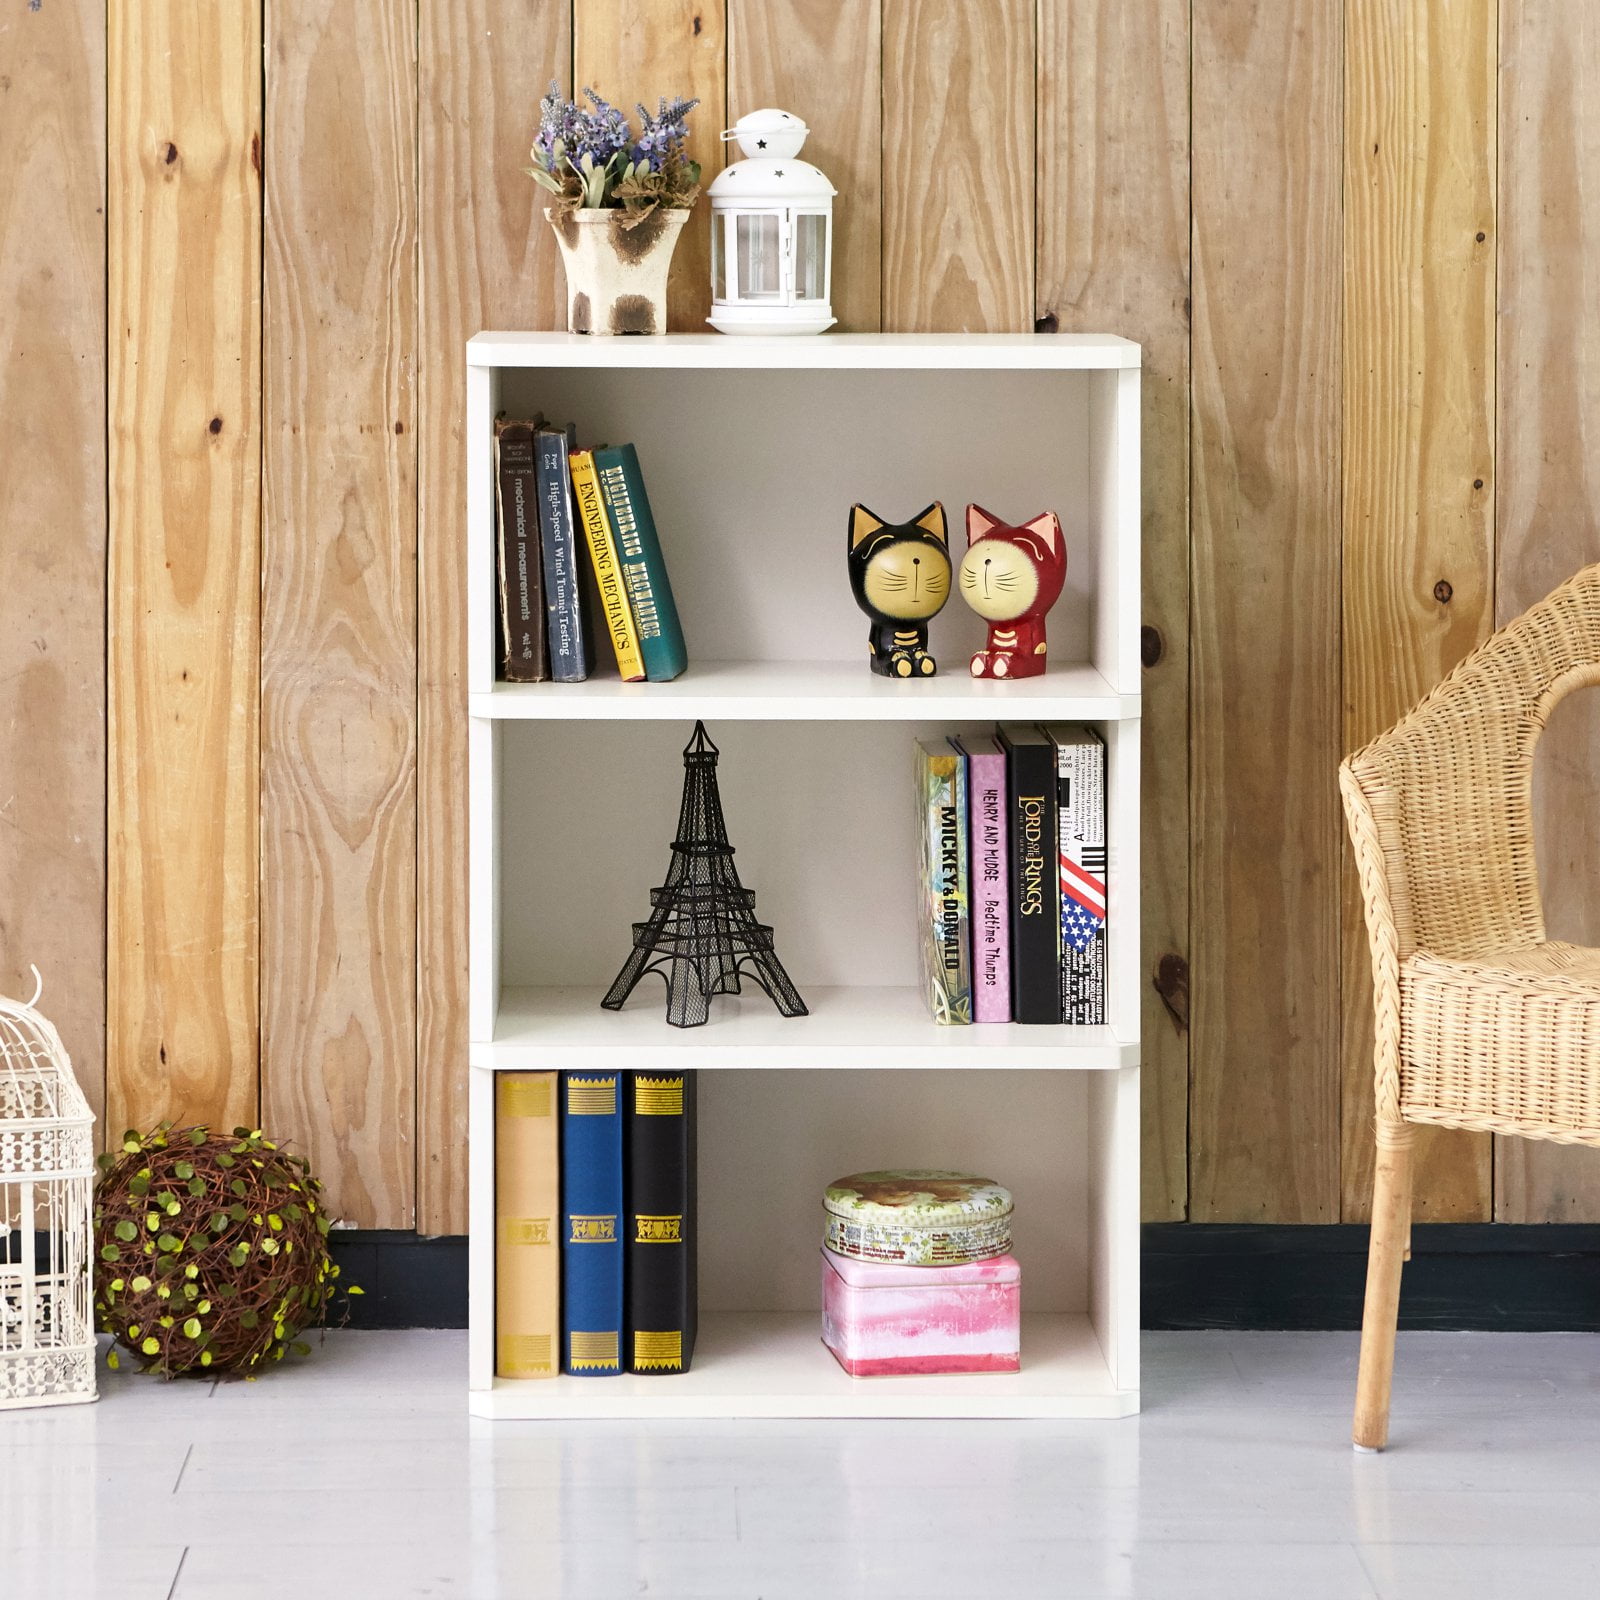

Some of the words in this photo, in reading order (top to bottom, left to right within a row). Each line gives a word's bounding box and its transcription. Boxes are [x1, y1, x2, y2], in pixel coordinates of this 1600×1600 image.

[550, 453, 558, 470] Pope
[514, 478, 528, 538] mechanical
[547, 481, 564, 542] High-Speed
[605, 465, 643, 557] ENGINEERING
[518, 542, 531, 621] measurements
[554, 547, 567, 577] Wind
[580, 481, 612, 570] ENGINEERING
[601, 573, 630, 651] MECHANICS
[556, 577, 569, 614] Tunnel
[559, 614, 571, 656] Testing
[983, 789, 999, 822] HENRY
[1018, 795, 1045, 842] LORD
[941, 806, 959, 887] MICKEY
[984, 825, 999, 845] AND
[1026, 841, 1035, 858] THE
[1033, 842, 1041, 855] OF
[1073, 833, 1085, 842] A
[984, 849, 1000, 881] MUDGE
[943, 887, 955, 897] &
[1019, 856, 1045, 916] RINGS
[943, 899, 960, 970] DONALD
[984, 900, 1000, 943] Bedtime
[984, 947, 1001, 986] Thumps
